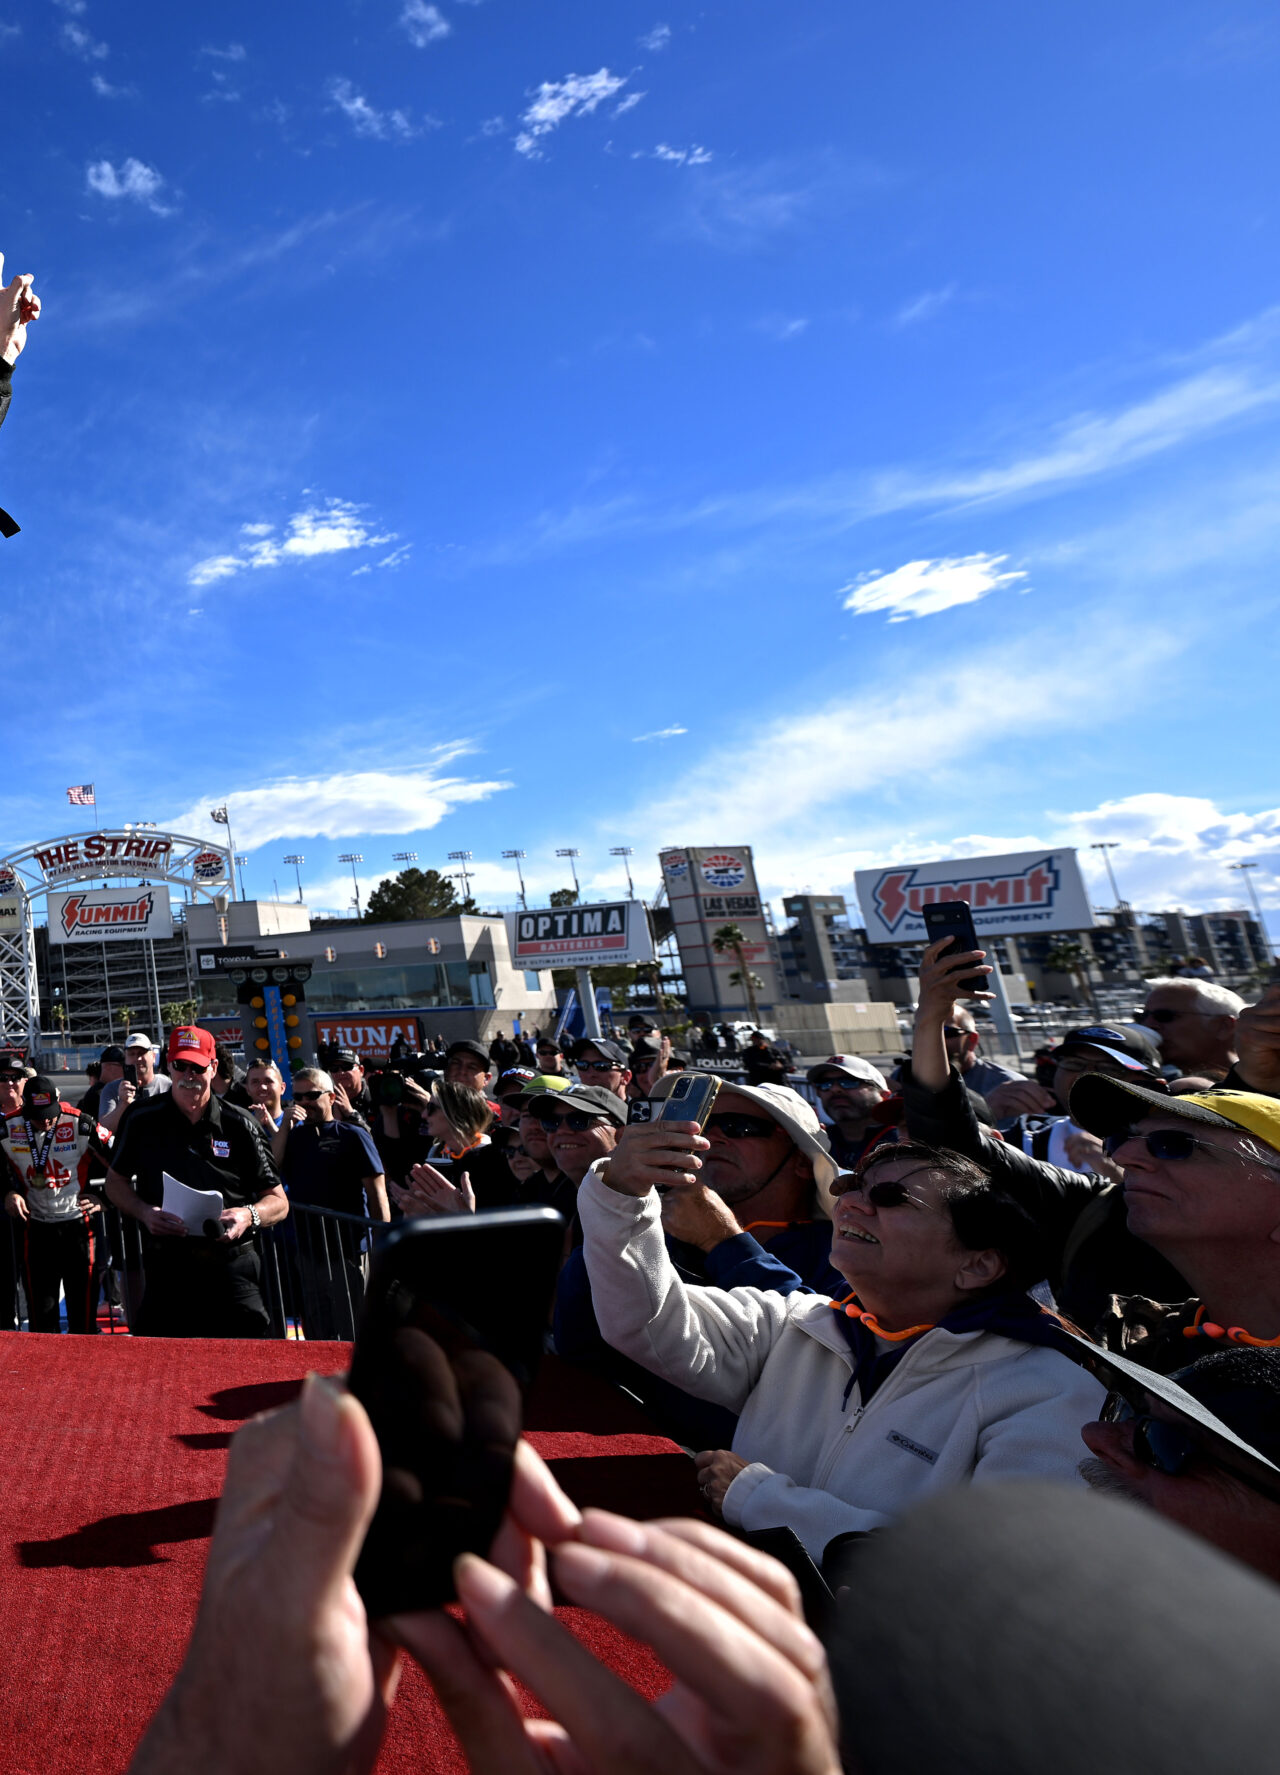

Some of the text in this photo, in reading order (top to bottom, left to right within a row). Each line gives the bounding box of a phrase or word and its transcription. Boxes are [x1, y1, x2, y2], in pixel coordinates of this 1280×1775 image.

[33, 835, 172, 870] THE STRIP
[72, 861, 94, 870] VEGAS
[121, 860, 159, 869] SPEEDWAY
[521, 909, 622, 939] OPTIMA
[75, 926, 148, 936] RACING EQUIPMENT
[540, 940, 604, 952] BATTERIES
[501, 1066, 535, 1080] FORD
[214, 1140, 229, 1148] FOX
